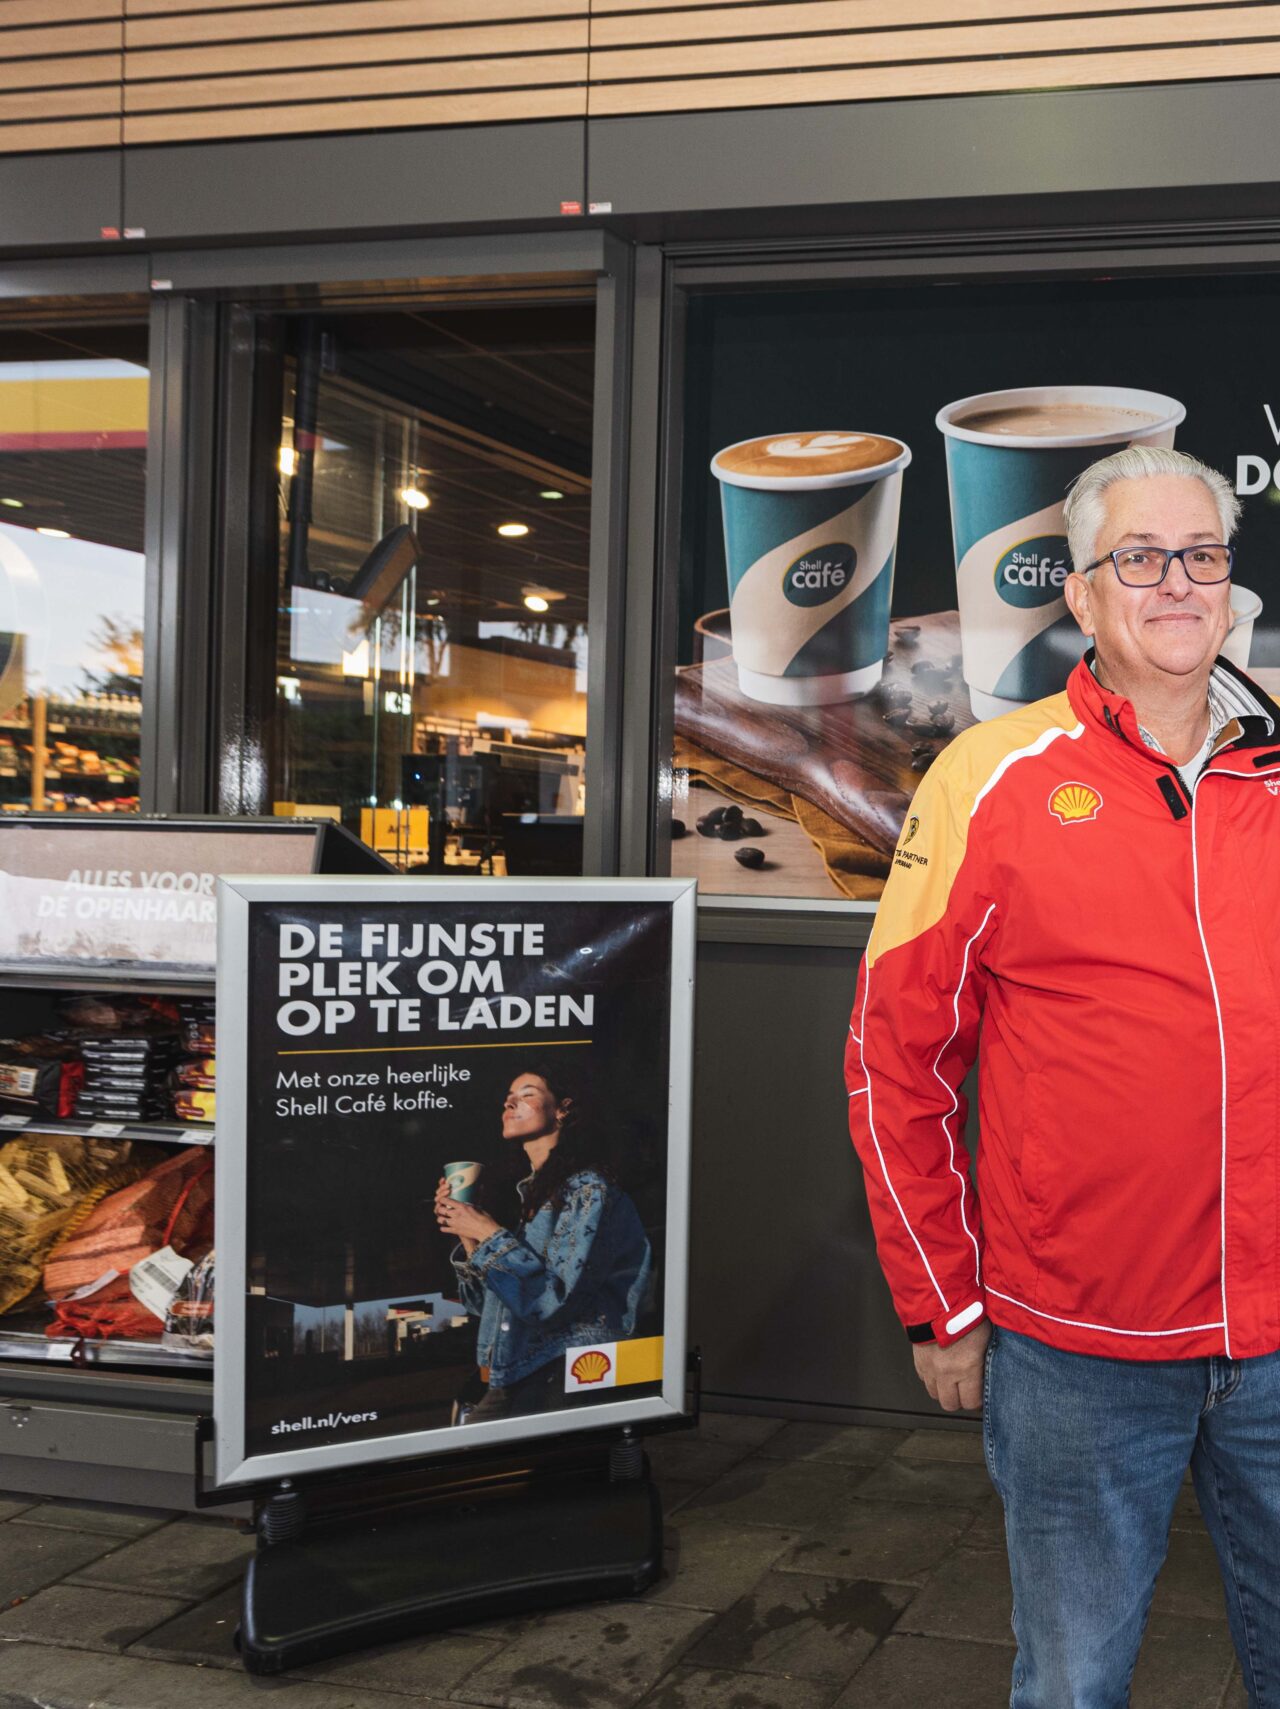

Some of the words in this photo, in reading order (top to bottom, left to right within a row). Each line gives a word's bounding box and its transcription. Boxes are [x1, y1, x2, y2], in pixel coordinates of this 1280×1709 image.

[799, 559, 822, 571] Shell
[1004, 557, 1068, 587] café
[1012, 552, 1038, 565] Shell
[791, 561, 846, 589] café
[901, 850, 929, 867] PARTNER
[64, 869, 133, 892] ALLES
[140, 871, 216, 897] VOOR
[37, 896, 68, 918] DE
[75, 898, 216, 923] OPENHAAR
[279, 923, 343, 958] DE
[361, 922, 545, 958] FIJNSTE
[278, 961, 401, 997] PLEK
[417, 959, 504, 995] OM
[276, 1000, 356, 1036] OP
[369, 998, 421, 1033] TE
[438, 994, 595, 1031] LADEN
[276, 1070, 321, 1089] Met
[327, 1073, 380, 1087] onze
[387, 1063, 471, 1087] heerlijke
[276, 1095, 328, 1117] Shell
[335, 1093, 386, 1114] Café
[393, 1090, 454, 1111] koffie.
[271, 1411, 378, 1435] shell.nl/vers
